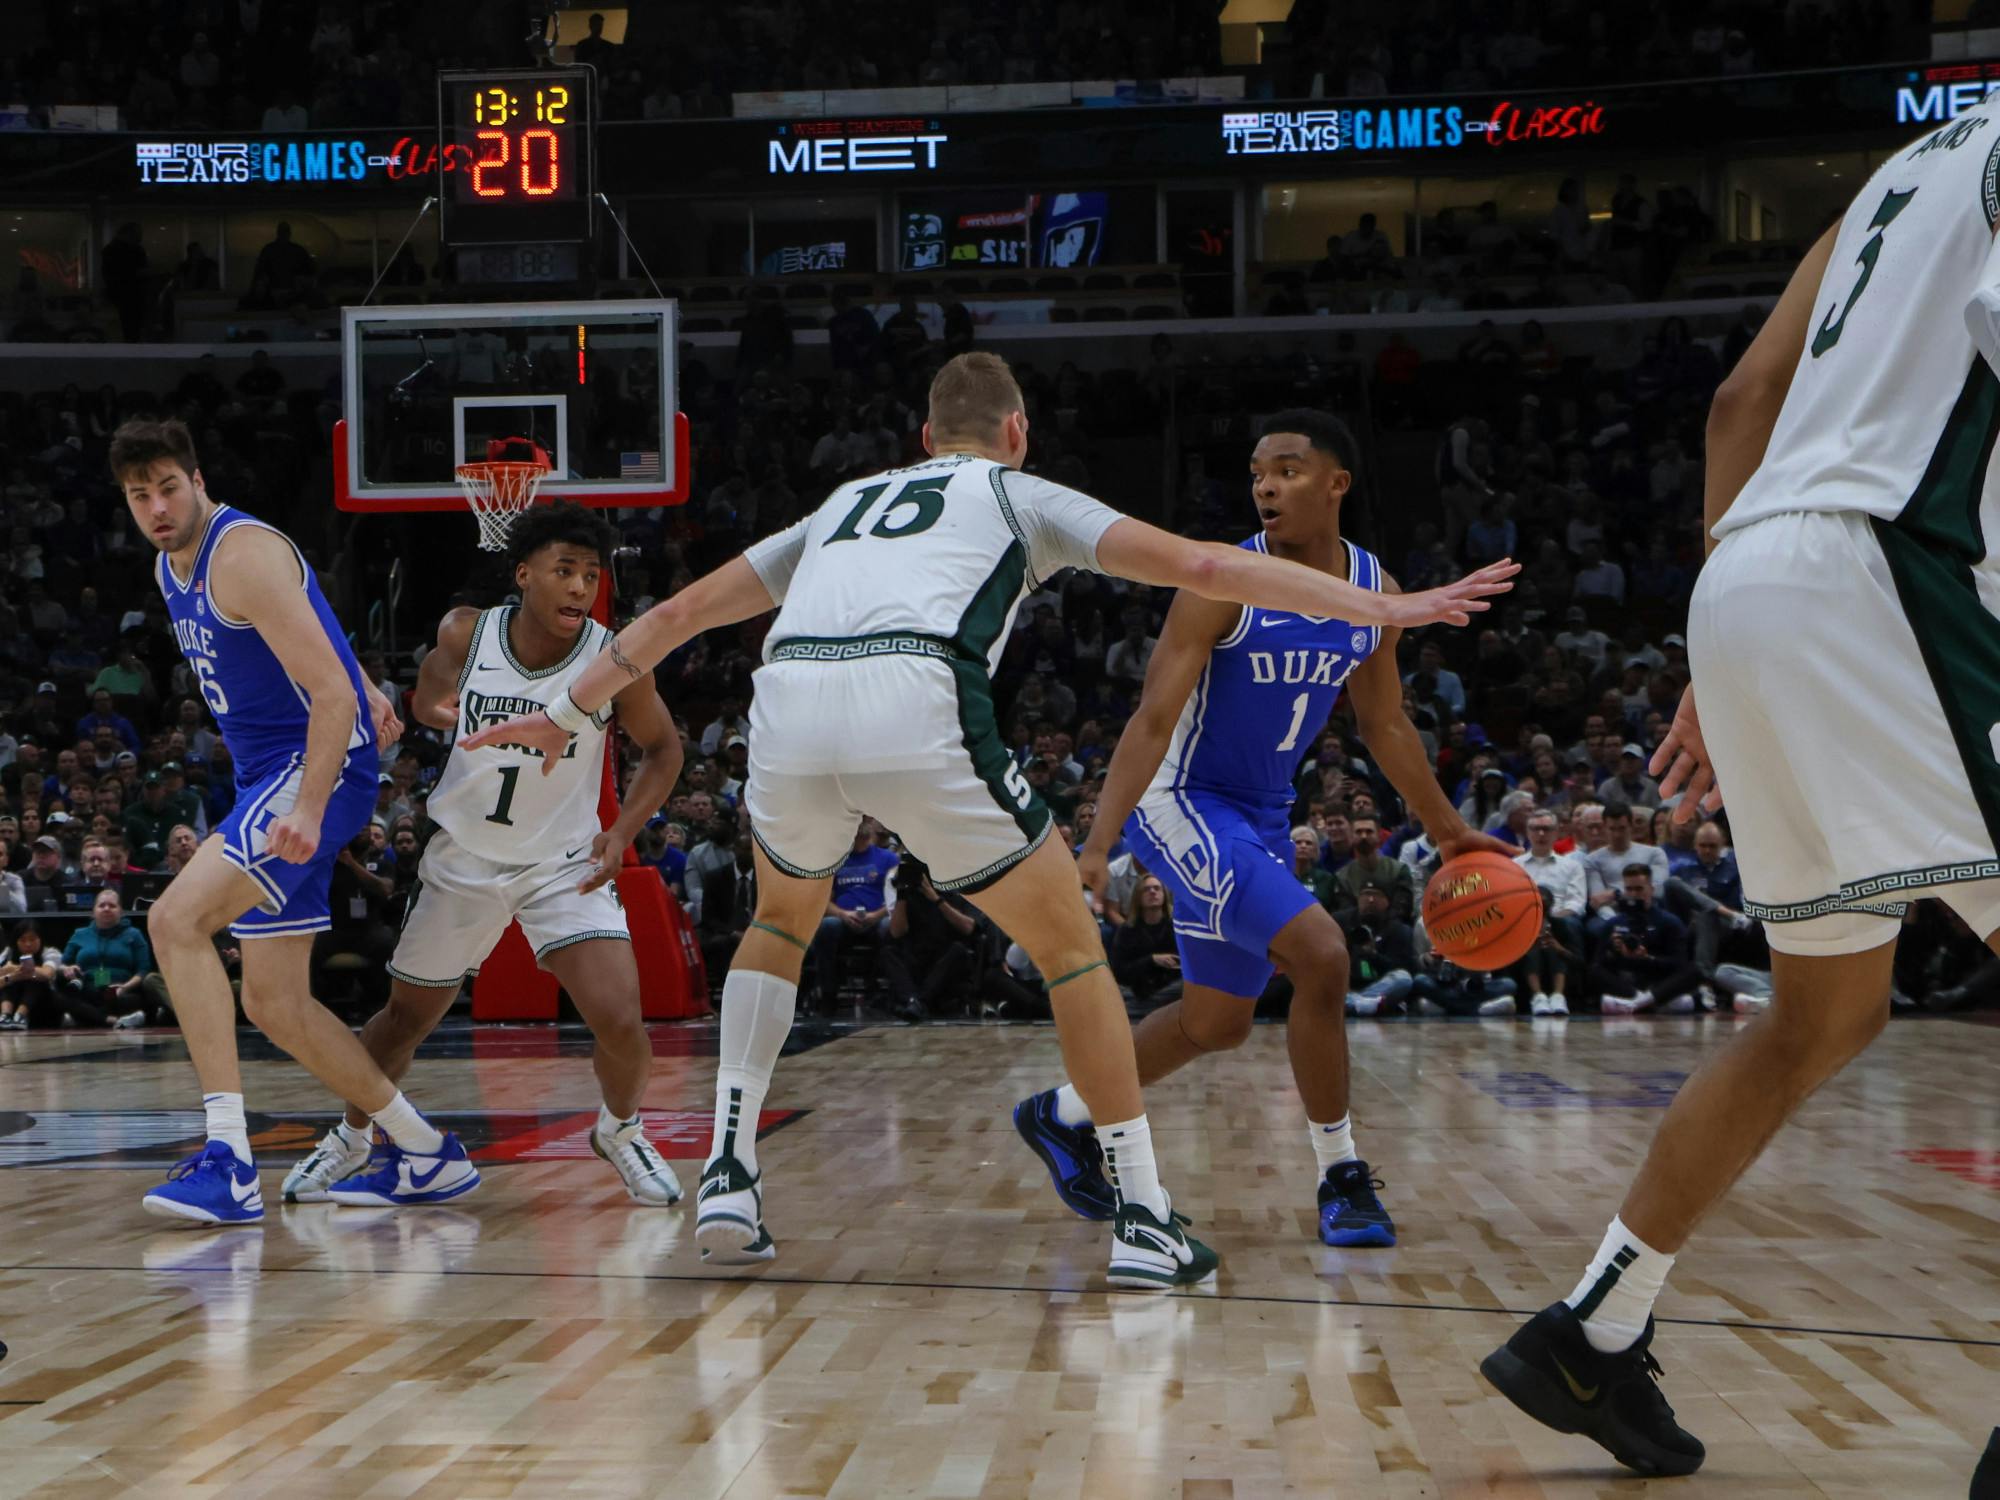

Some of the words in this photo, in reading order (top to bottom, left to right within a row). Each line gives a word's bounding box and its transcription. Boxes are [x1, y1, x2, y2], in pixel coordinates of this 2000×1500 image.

[1261, 109, 1339, 128] FOUR
[1896, 82, 2000, 123] ME
[1223, 126, 1340, 154] TEAMS
[1354, 106, 1463, 149] GAMES
[136, 158, 249, 182] TEAMS
[172, 143, 248, 159] FOUR
[263, 141, 366, 182] GAMES
[472, 130, 559, 196] 20
[768, 135, 948, 174] MEET
[821, 472, 956, 549] 15
[1275, 692, 1309, 752] 1
[485, 766, 521, 827] 1
